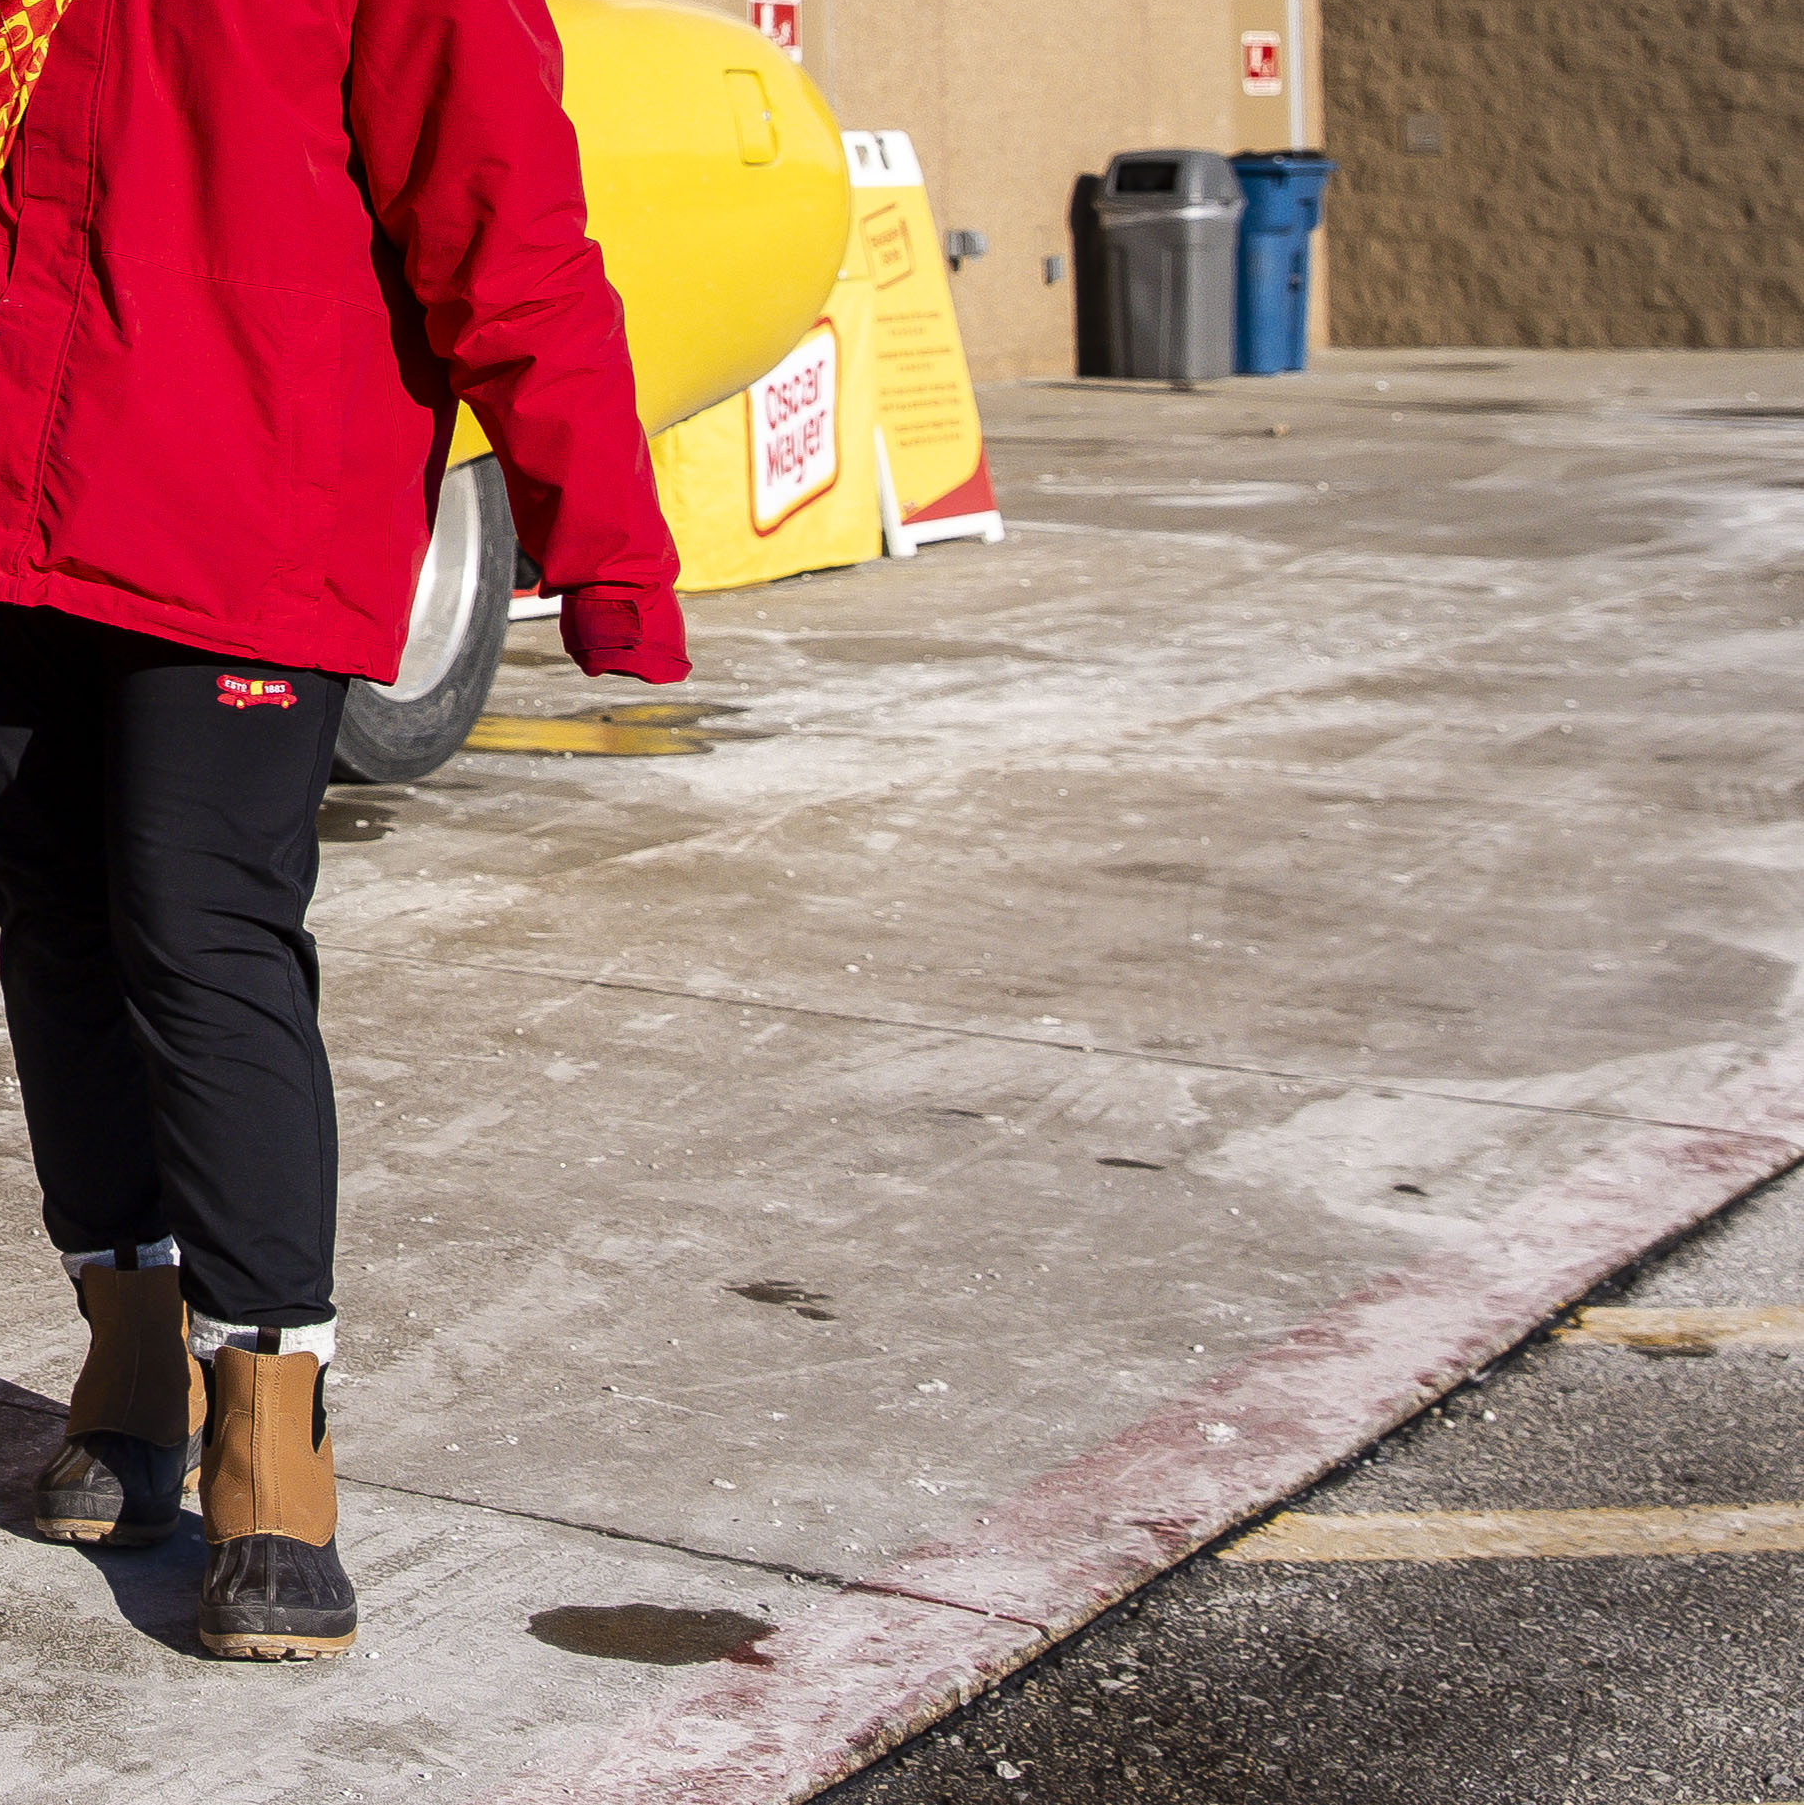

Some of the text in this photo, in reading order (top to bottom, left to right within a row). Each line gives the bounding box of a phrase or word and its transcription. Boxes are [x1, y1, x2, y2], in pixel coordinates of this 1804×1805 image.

[765, 359, 825, 430] Oscar
[766, 409, 826, 487] Mayer
[263, 684, 287, 694] 1883
